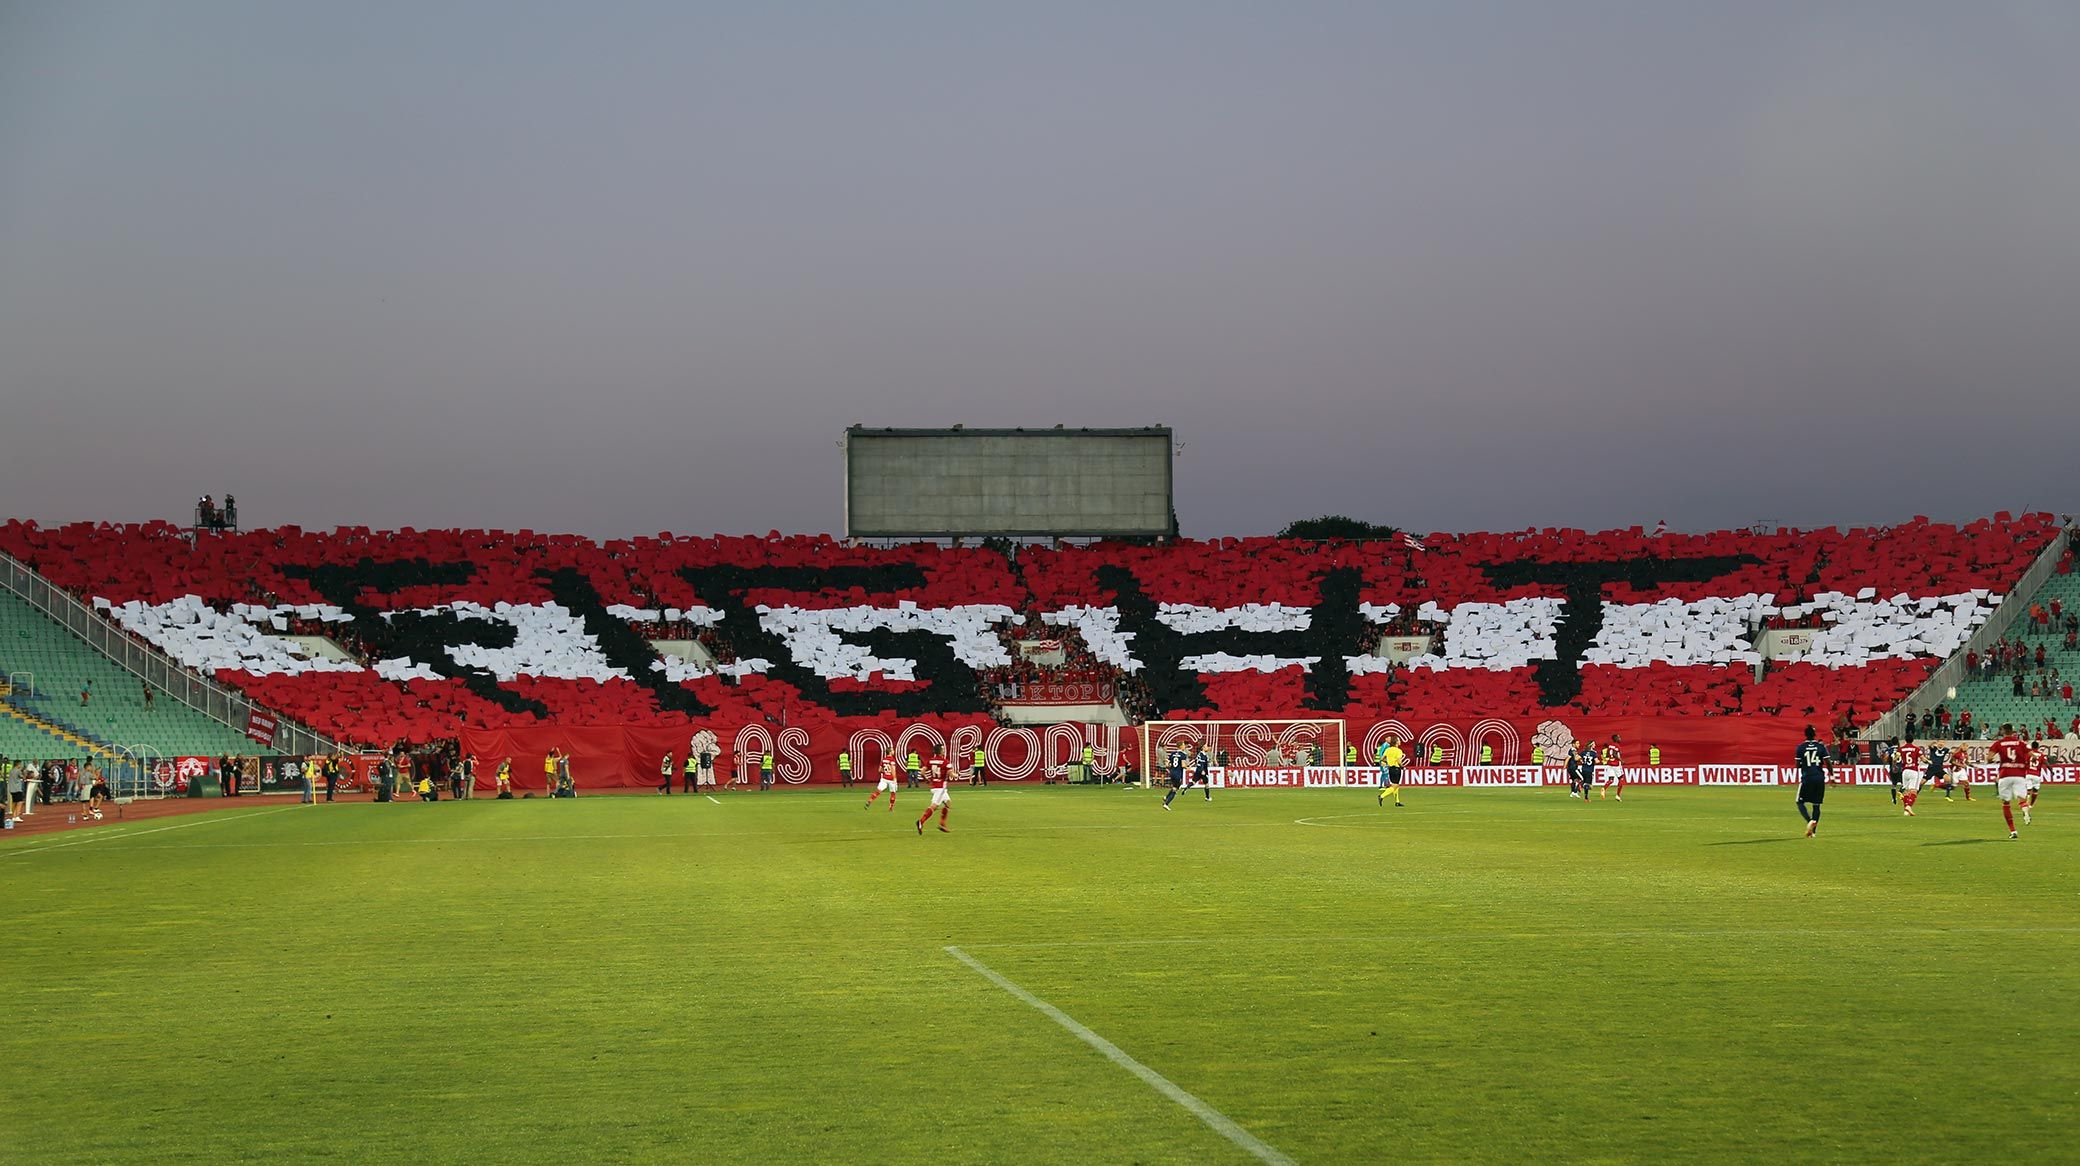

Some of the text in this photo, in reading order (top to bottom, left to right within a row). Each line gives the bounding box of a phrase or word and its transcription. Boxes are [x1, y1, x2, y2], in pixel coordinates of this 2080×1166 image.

[734, 723, 812, 785] AS
[1363, 718, 1519, 767] CAN
[1804, 750, 1821, 767] 14
[1905, 751, 1913, 764] 6
[2006, 746, 2017, 763] 4
[1172, 757, 1179, 768] 8
[1227, 769, 1301, 785] WINBET
[1467, 769, 1539, 785] WINBET
[1623, 768, 1696, 784] WINBET
[1703, 768, 1775, 784] WINBET
